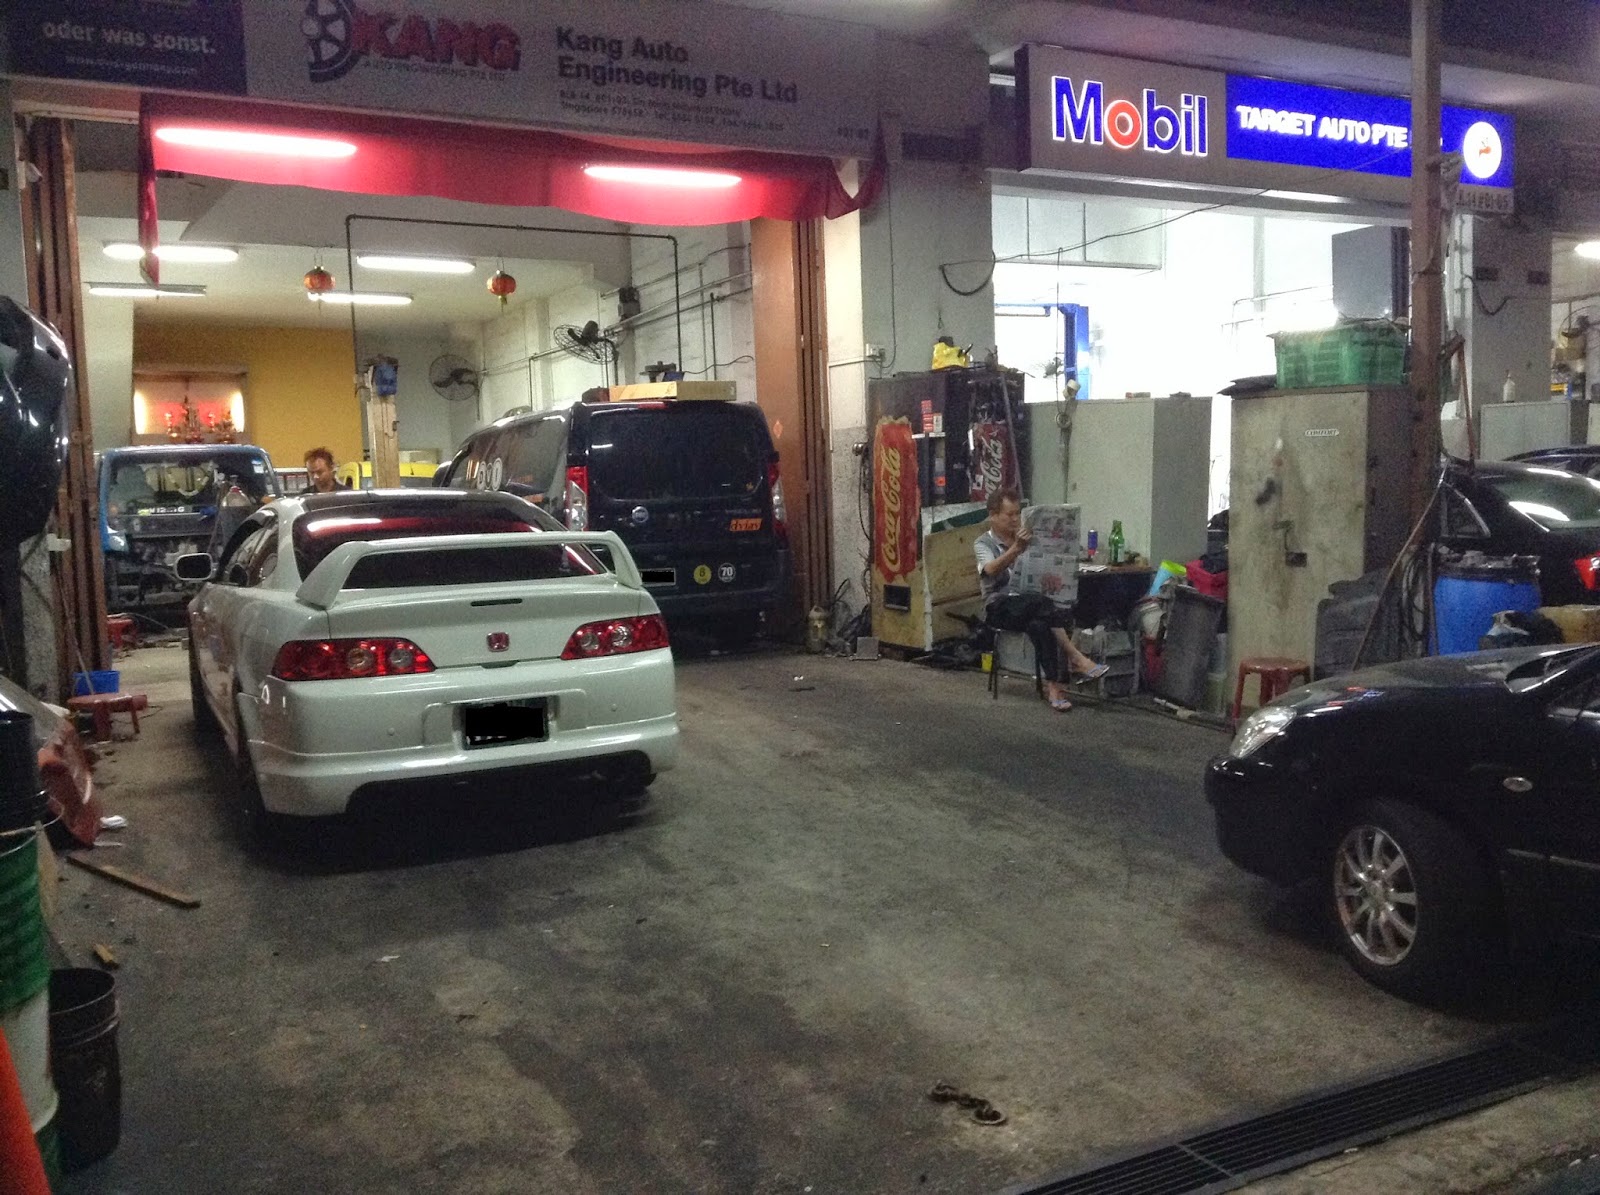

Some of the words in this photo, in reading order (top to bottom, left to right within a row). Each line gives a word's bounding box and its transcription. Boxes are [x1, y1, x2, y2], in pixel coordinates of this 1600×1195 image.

[43, 20, 94, 42] oder
[102, 28, 146, 47] was
[152, 32, 216, 54] sonst.
[556, 26, 623, 60] Kang
[632, 36, 689, 63] Auto
[557, 56, 707, 98] Engineering
[714, 74, 753, 98] Pte
[761, 78, 798, 103] Ltd
[1051, 75, 1209, 157] Mobil
[1235, 104, 1316, 137] TARGET
[1317, 118, 1371, 143] AUTO
[1371, 121, 1408, 148] PTE
[721, 567, 733, 577] 70
